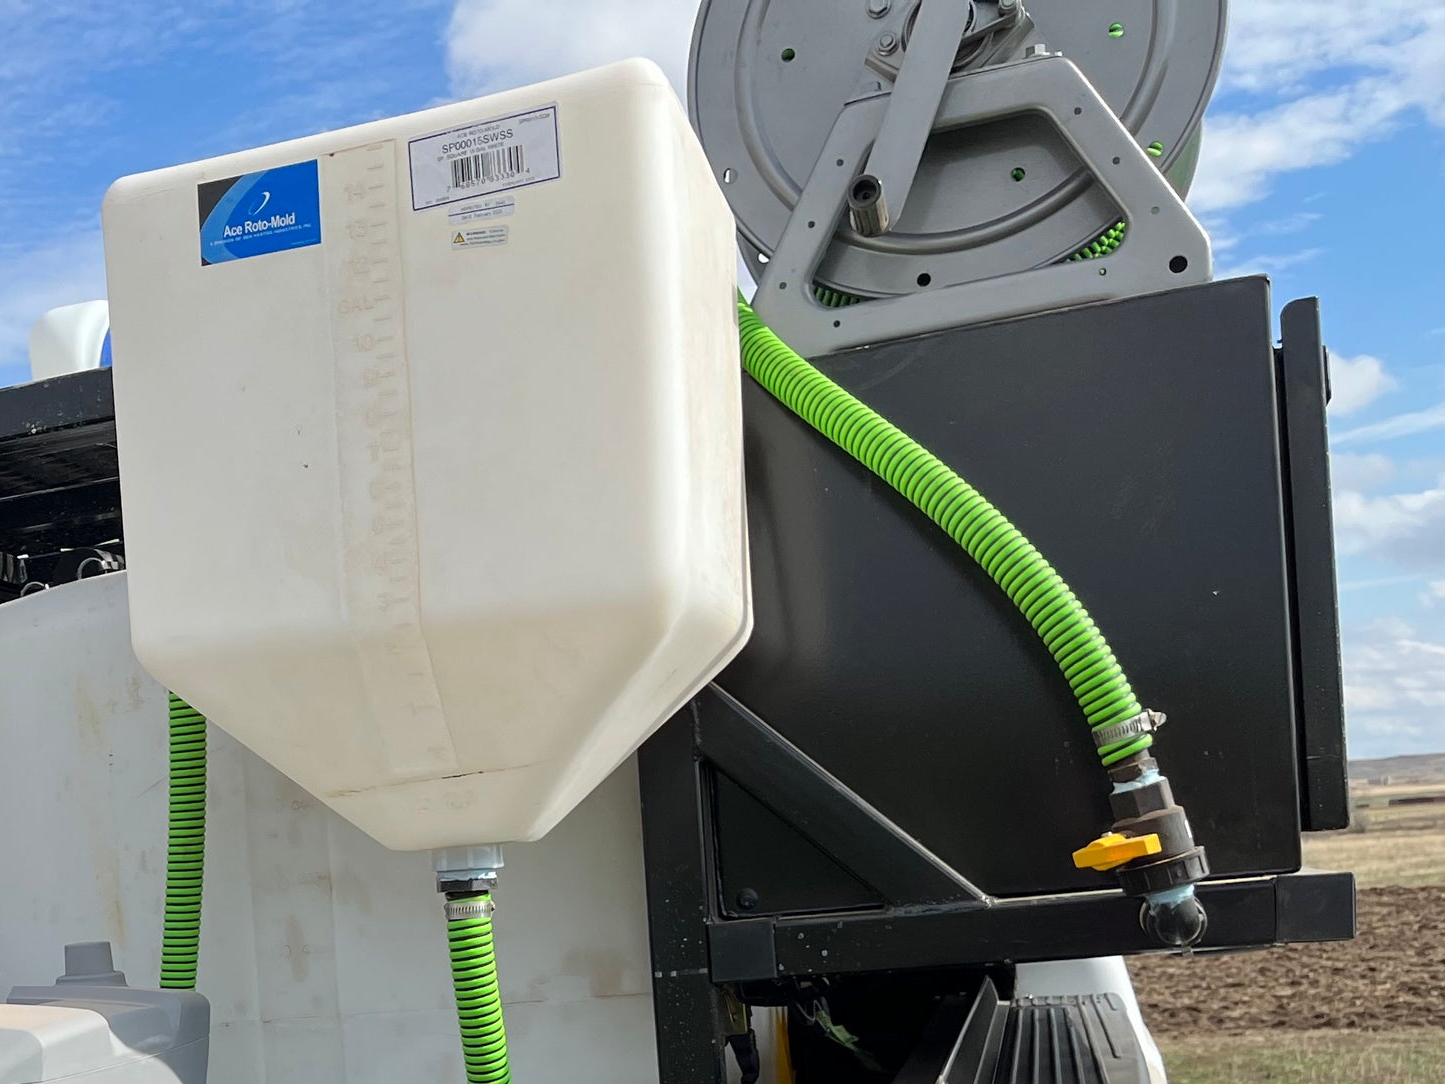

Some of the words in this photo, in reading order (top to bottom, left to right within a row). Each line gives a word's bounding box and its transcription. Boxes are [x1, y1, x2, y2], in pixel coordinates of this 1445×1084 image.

[442, 128, 514, 154] SP00015SWSS
[223, 225, 243, 238] Ace
[245, 212, 296, 233] Roto-Mold
